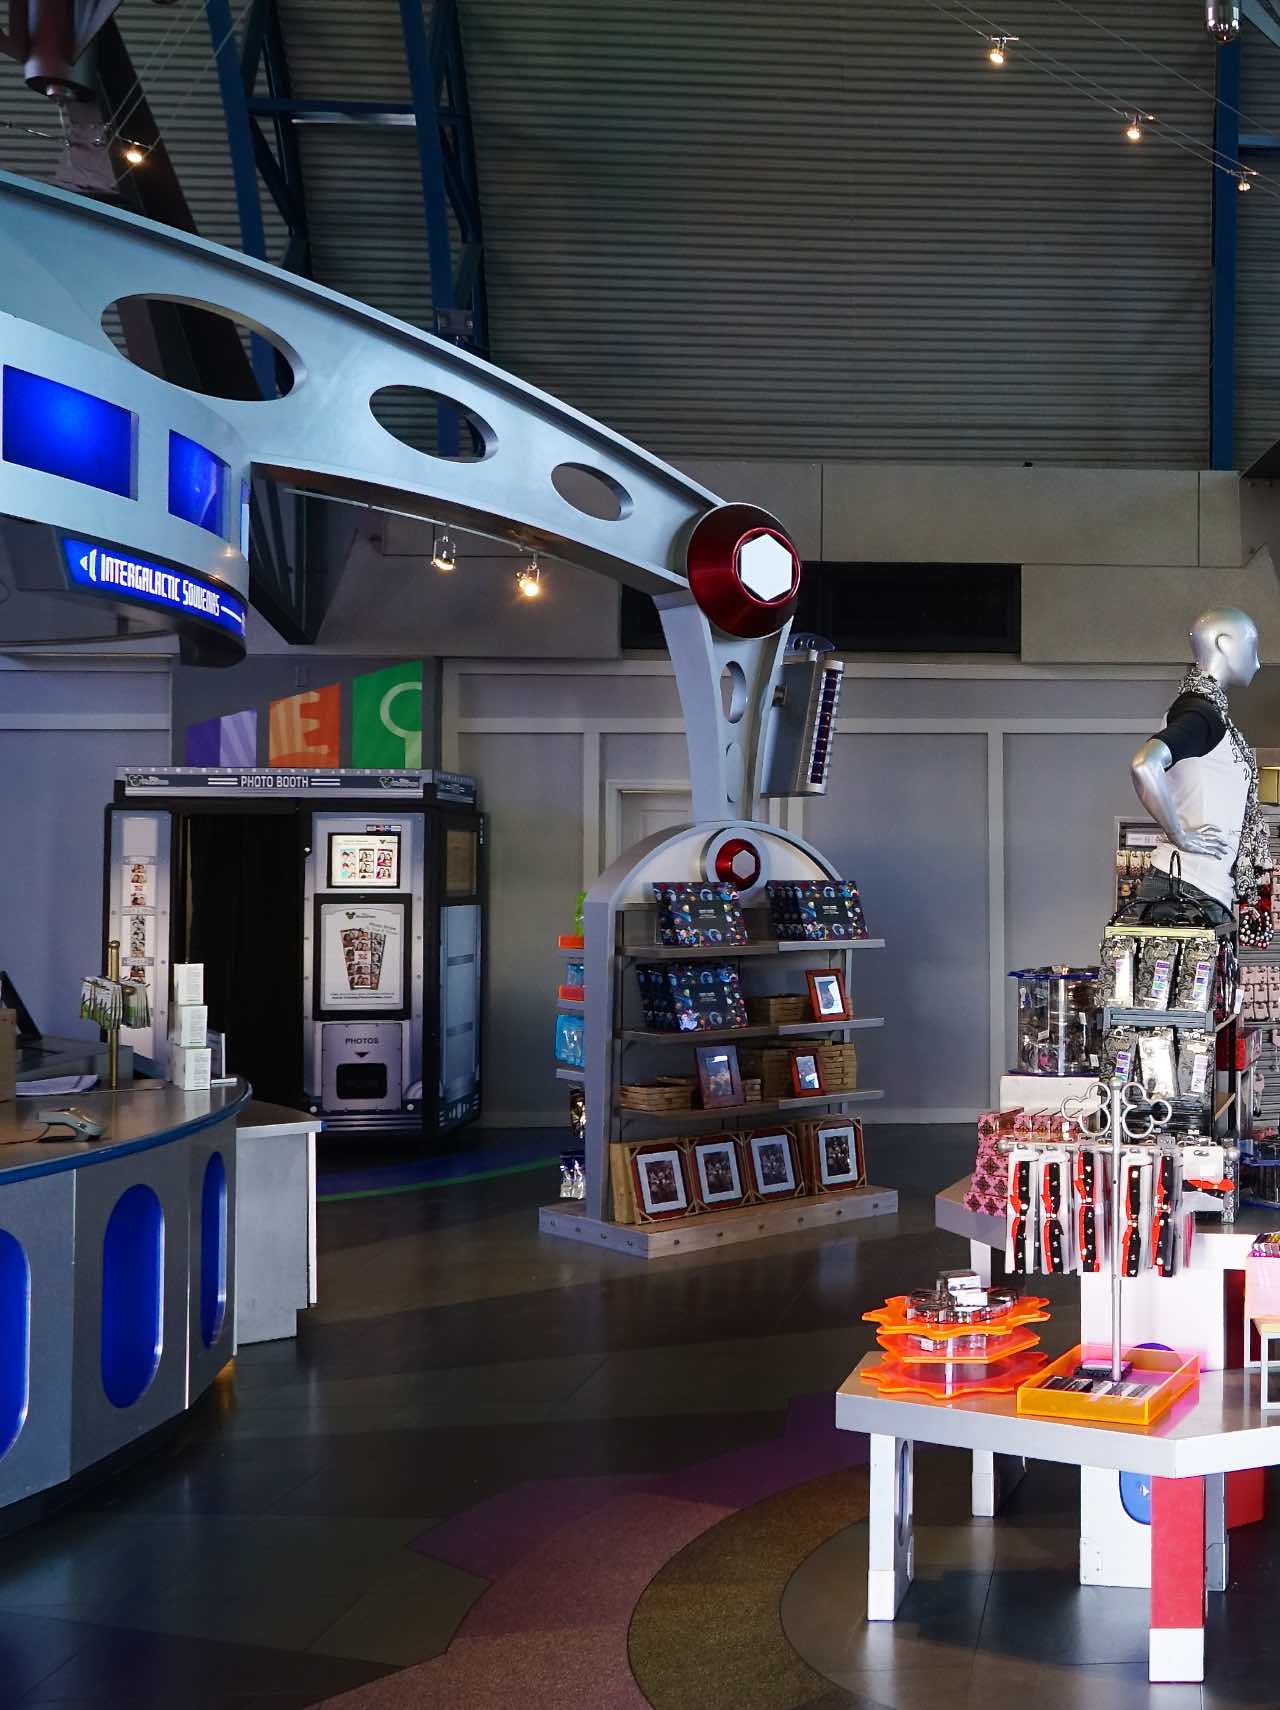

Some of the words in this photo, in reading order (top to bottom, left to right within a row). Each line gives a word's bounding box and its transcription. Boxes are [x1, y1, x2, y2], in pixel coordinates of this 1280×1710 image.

[100, 553, 181, 602] INTERGALACTIC
[241, 775, 274, 788] PHOTO
[276, 775, 309, 788] BOOTH
[345, 1037, 379, 1045] PHOTOS
